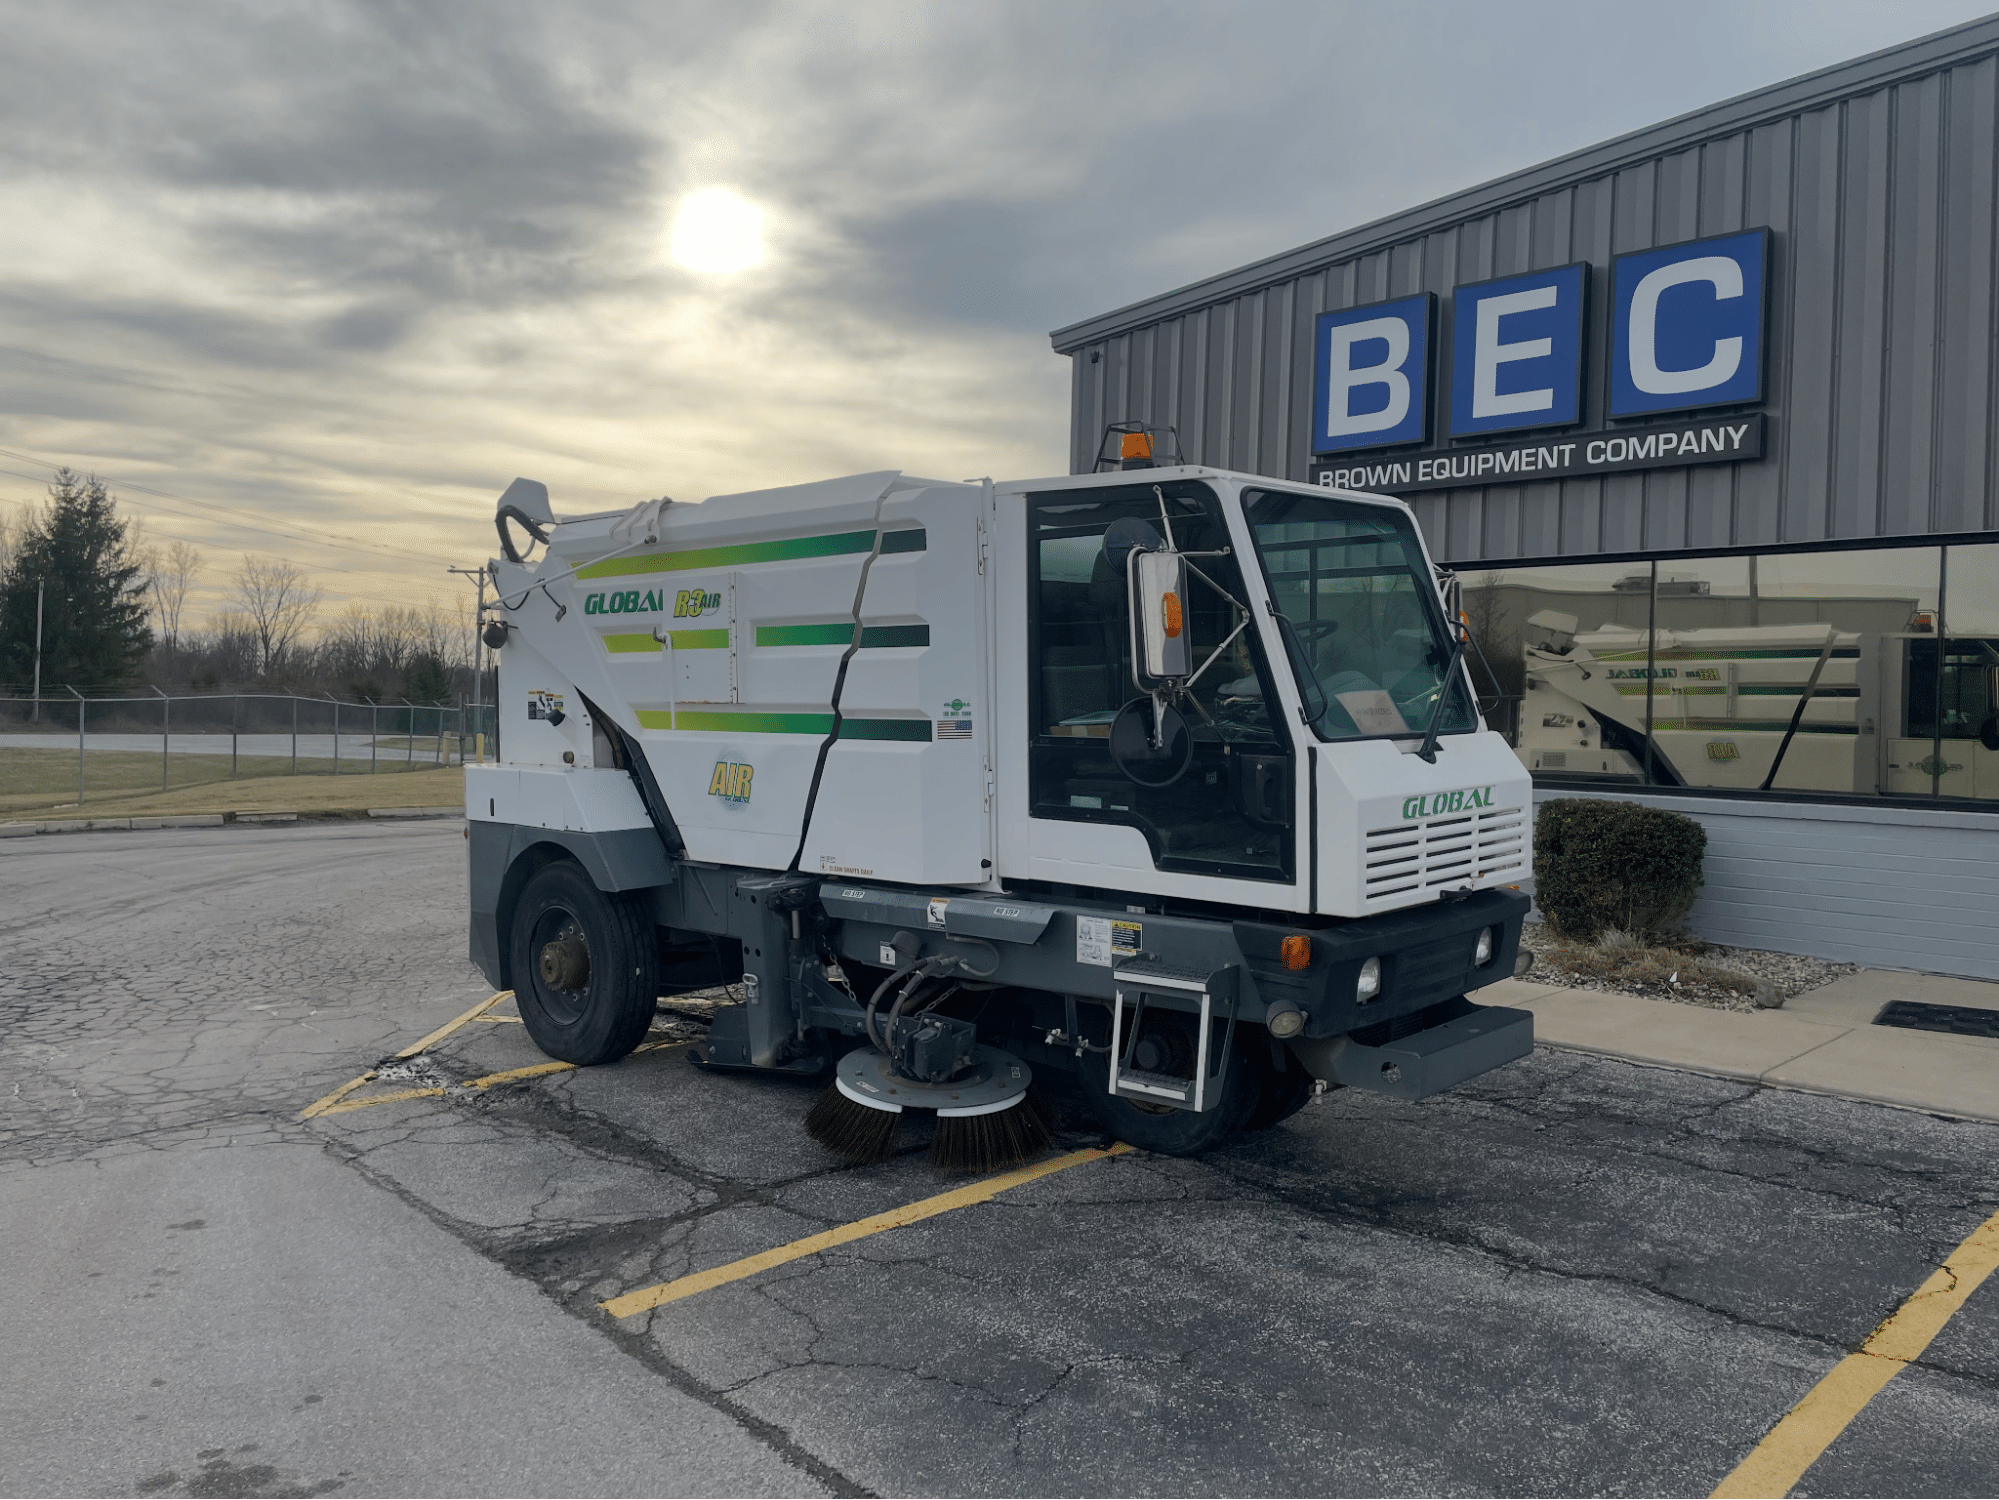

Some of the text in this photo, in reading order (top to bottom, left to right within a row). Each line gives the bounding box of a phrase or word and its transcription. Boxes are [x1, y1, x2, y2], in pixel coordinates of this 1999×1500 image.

[1319, 424, 1749, 489] BROWN EQUIPMENT COMPANY
[708, 761, 754, 799] AIR
[1402, 786, 1495, 819] GLOBAL
